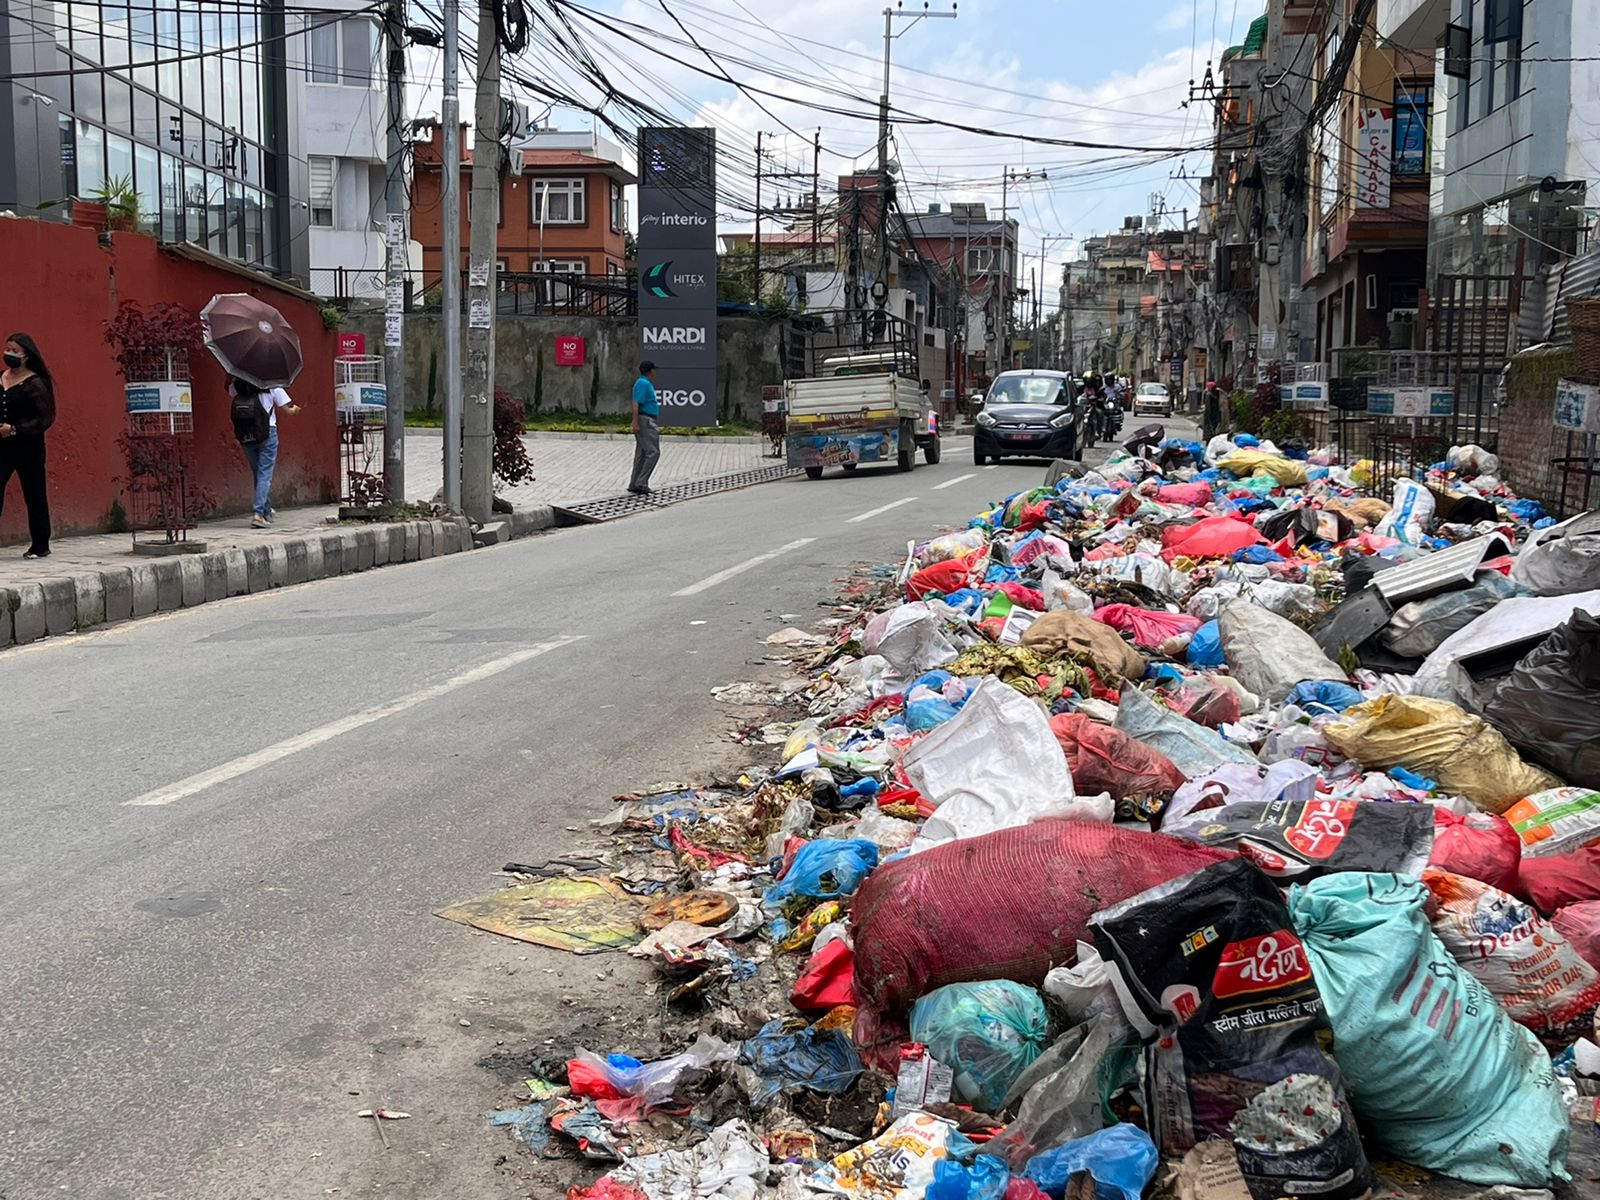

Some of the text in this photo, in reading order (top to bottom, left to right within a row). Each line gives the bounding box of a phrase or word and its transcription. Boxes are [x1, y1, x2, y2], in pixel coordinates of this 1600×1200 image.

[1368, 136, 1380, 204] CANADA
[662, 212, 707, 225] interio
[673, 274, 705, 283] HITEX
[643, 327, 706, 343] NARDI
[563, 342, 577, 350] NO
[1213, 1014, 1240, 1033] स्टीम
[1240, 1008, 1267, 1027] जीरा
